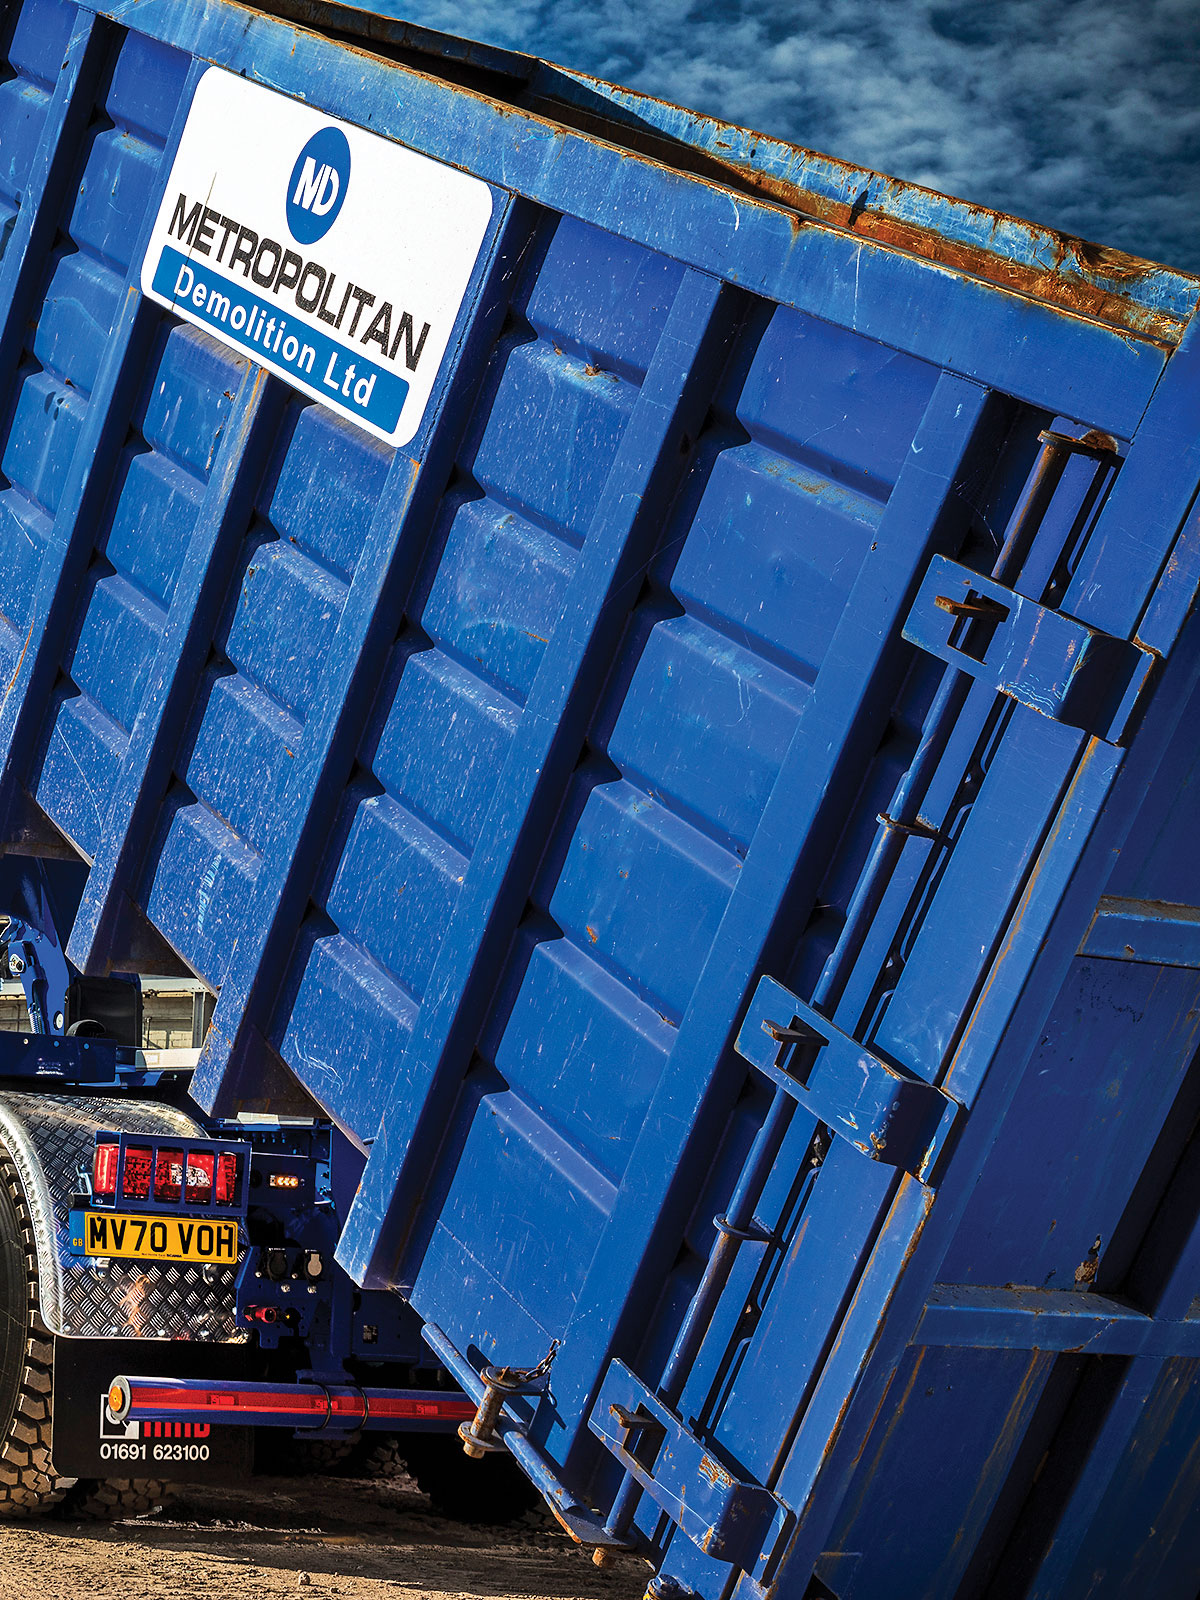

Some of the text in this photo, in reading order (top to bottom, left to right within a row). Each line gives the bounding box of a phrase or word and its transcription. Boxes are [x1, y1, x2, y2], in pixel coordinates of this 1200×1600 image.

[167, 193, 431, 372] METROPOLITAN
[173, 264, 377, 408] Demolition Ltd
[72, 1238, 83, 1246] GB
[90, 1217, 233, 1258] MV70 VOH
[100, 1443, 210, 1461] 01691 623100
